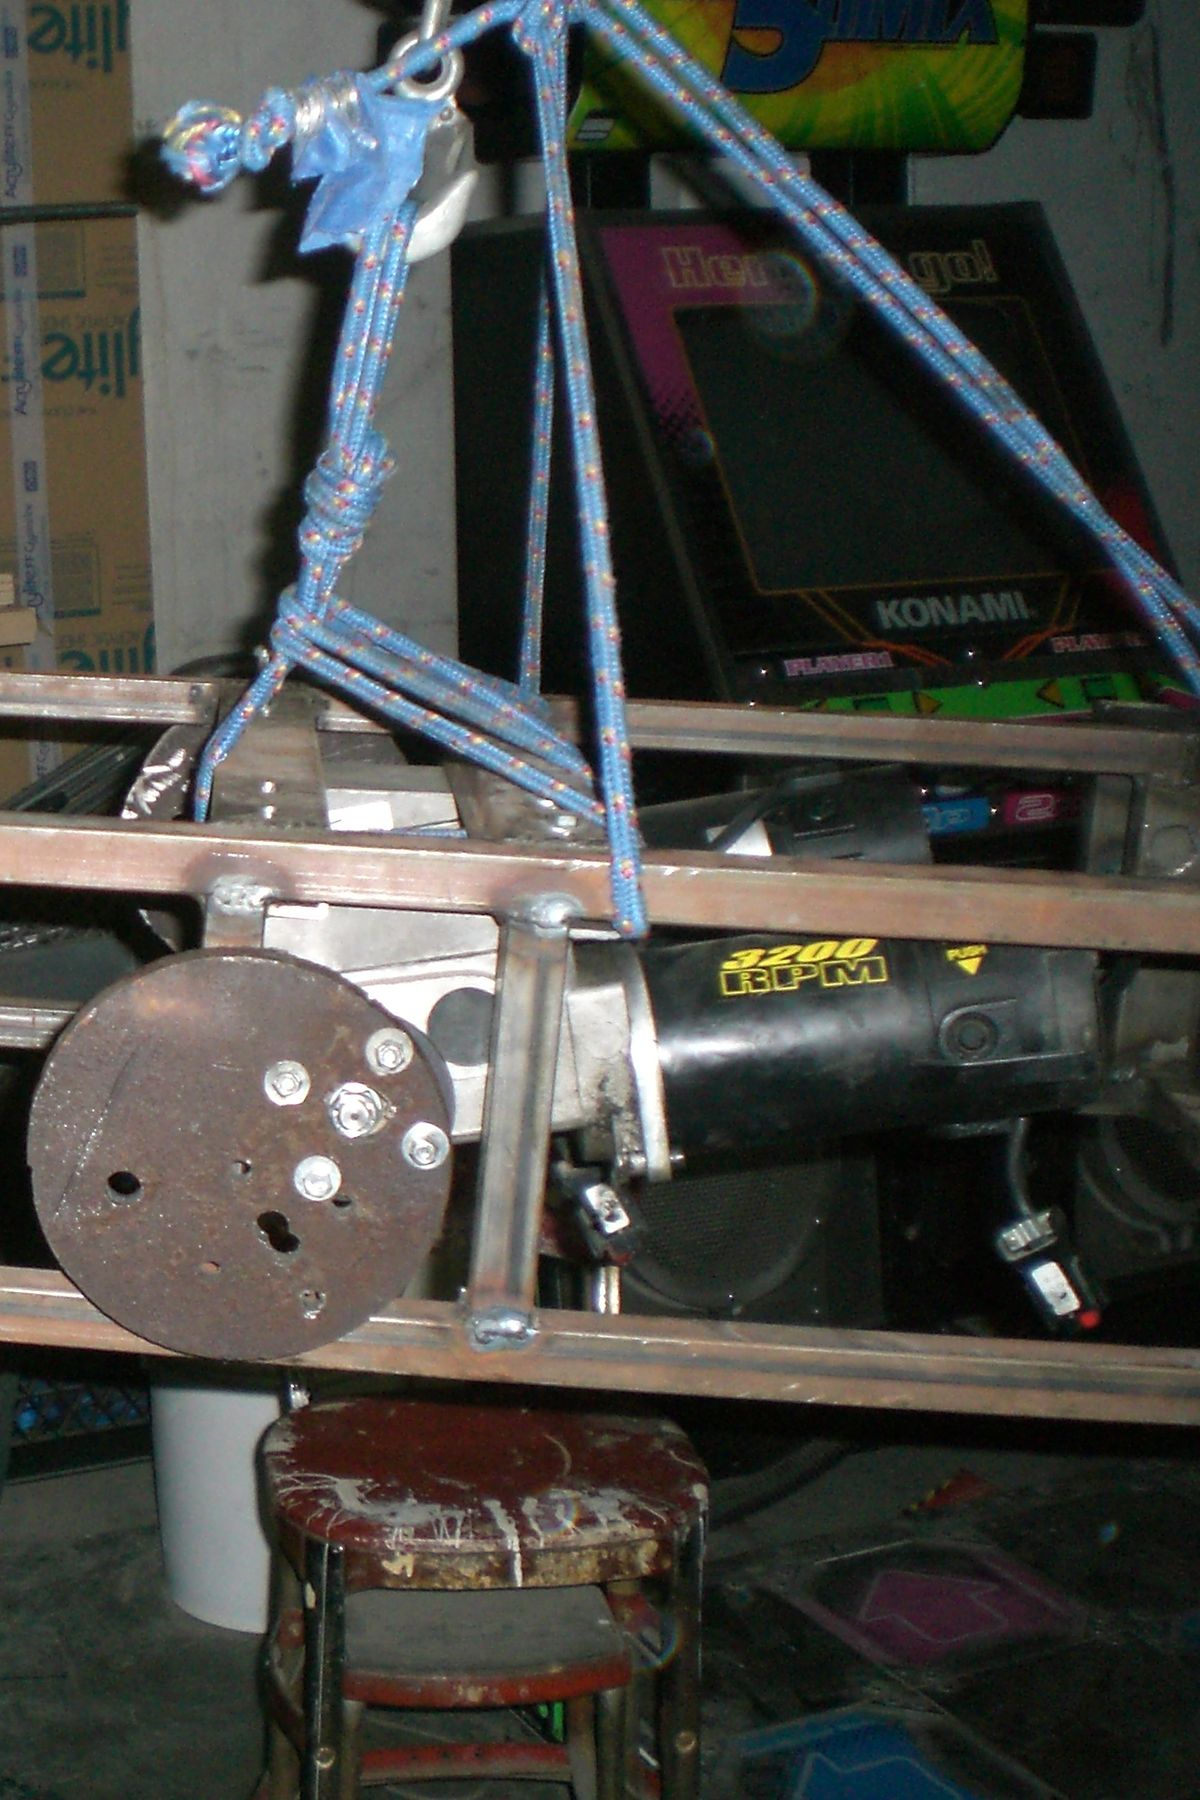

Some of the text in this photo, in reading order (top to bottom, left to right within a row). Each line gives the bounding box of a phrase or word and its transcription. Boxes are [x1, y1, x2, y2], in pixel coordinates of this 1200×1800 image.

[876, 591, 1031, 630] KONAMI
[721, 938, 879, 970] 3200
[719, 956, 889, 996] RPM
